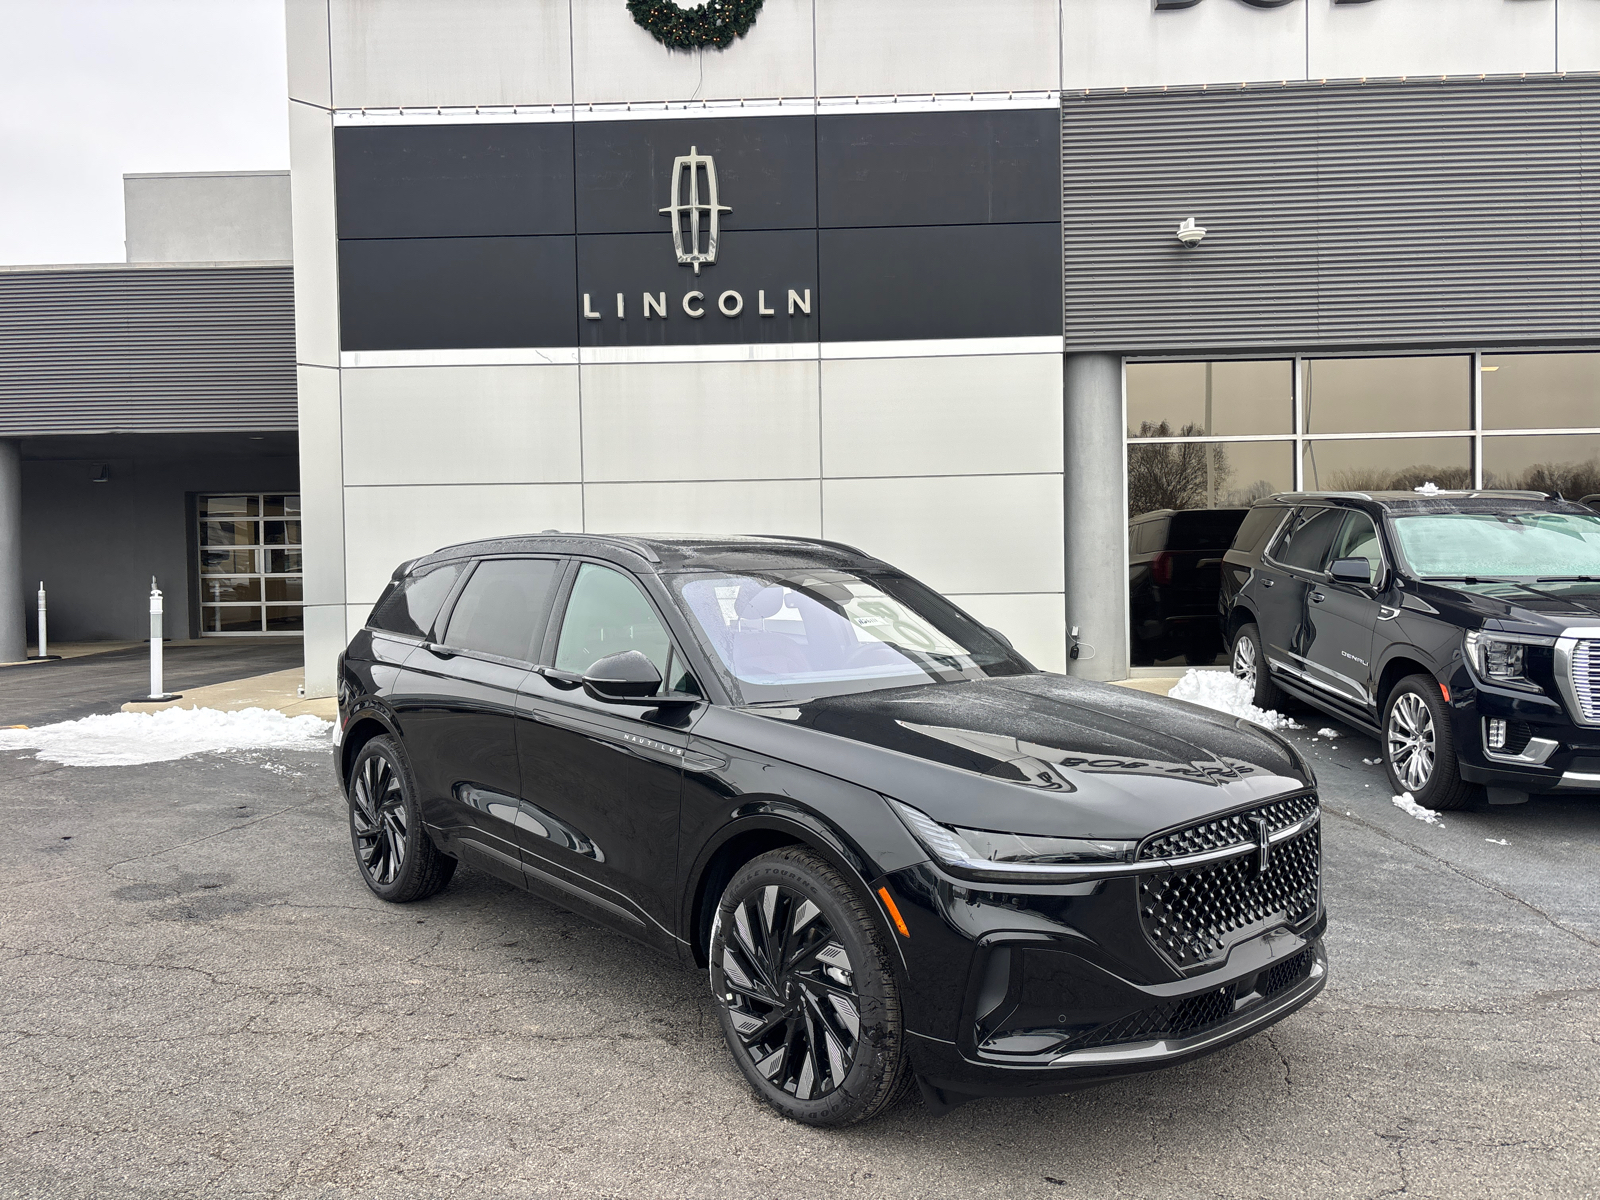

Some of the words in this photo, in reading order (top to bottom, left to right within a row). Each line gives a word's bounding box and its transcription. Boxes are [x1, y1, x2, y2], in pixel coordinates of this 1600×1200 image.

[583, 289, 811, 319] LINCOLN
[1341, 650, 1369, 667] DENALI
[623, 734, 682, 755] NAUTILUS
[765, 868, 818, 894] TOURING
